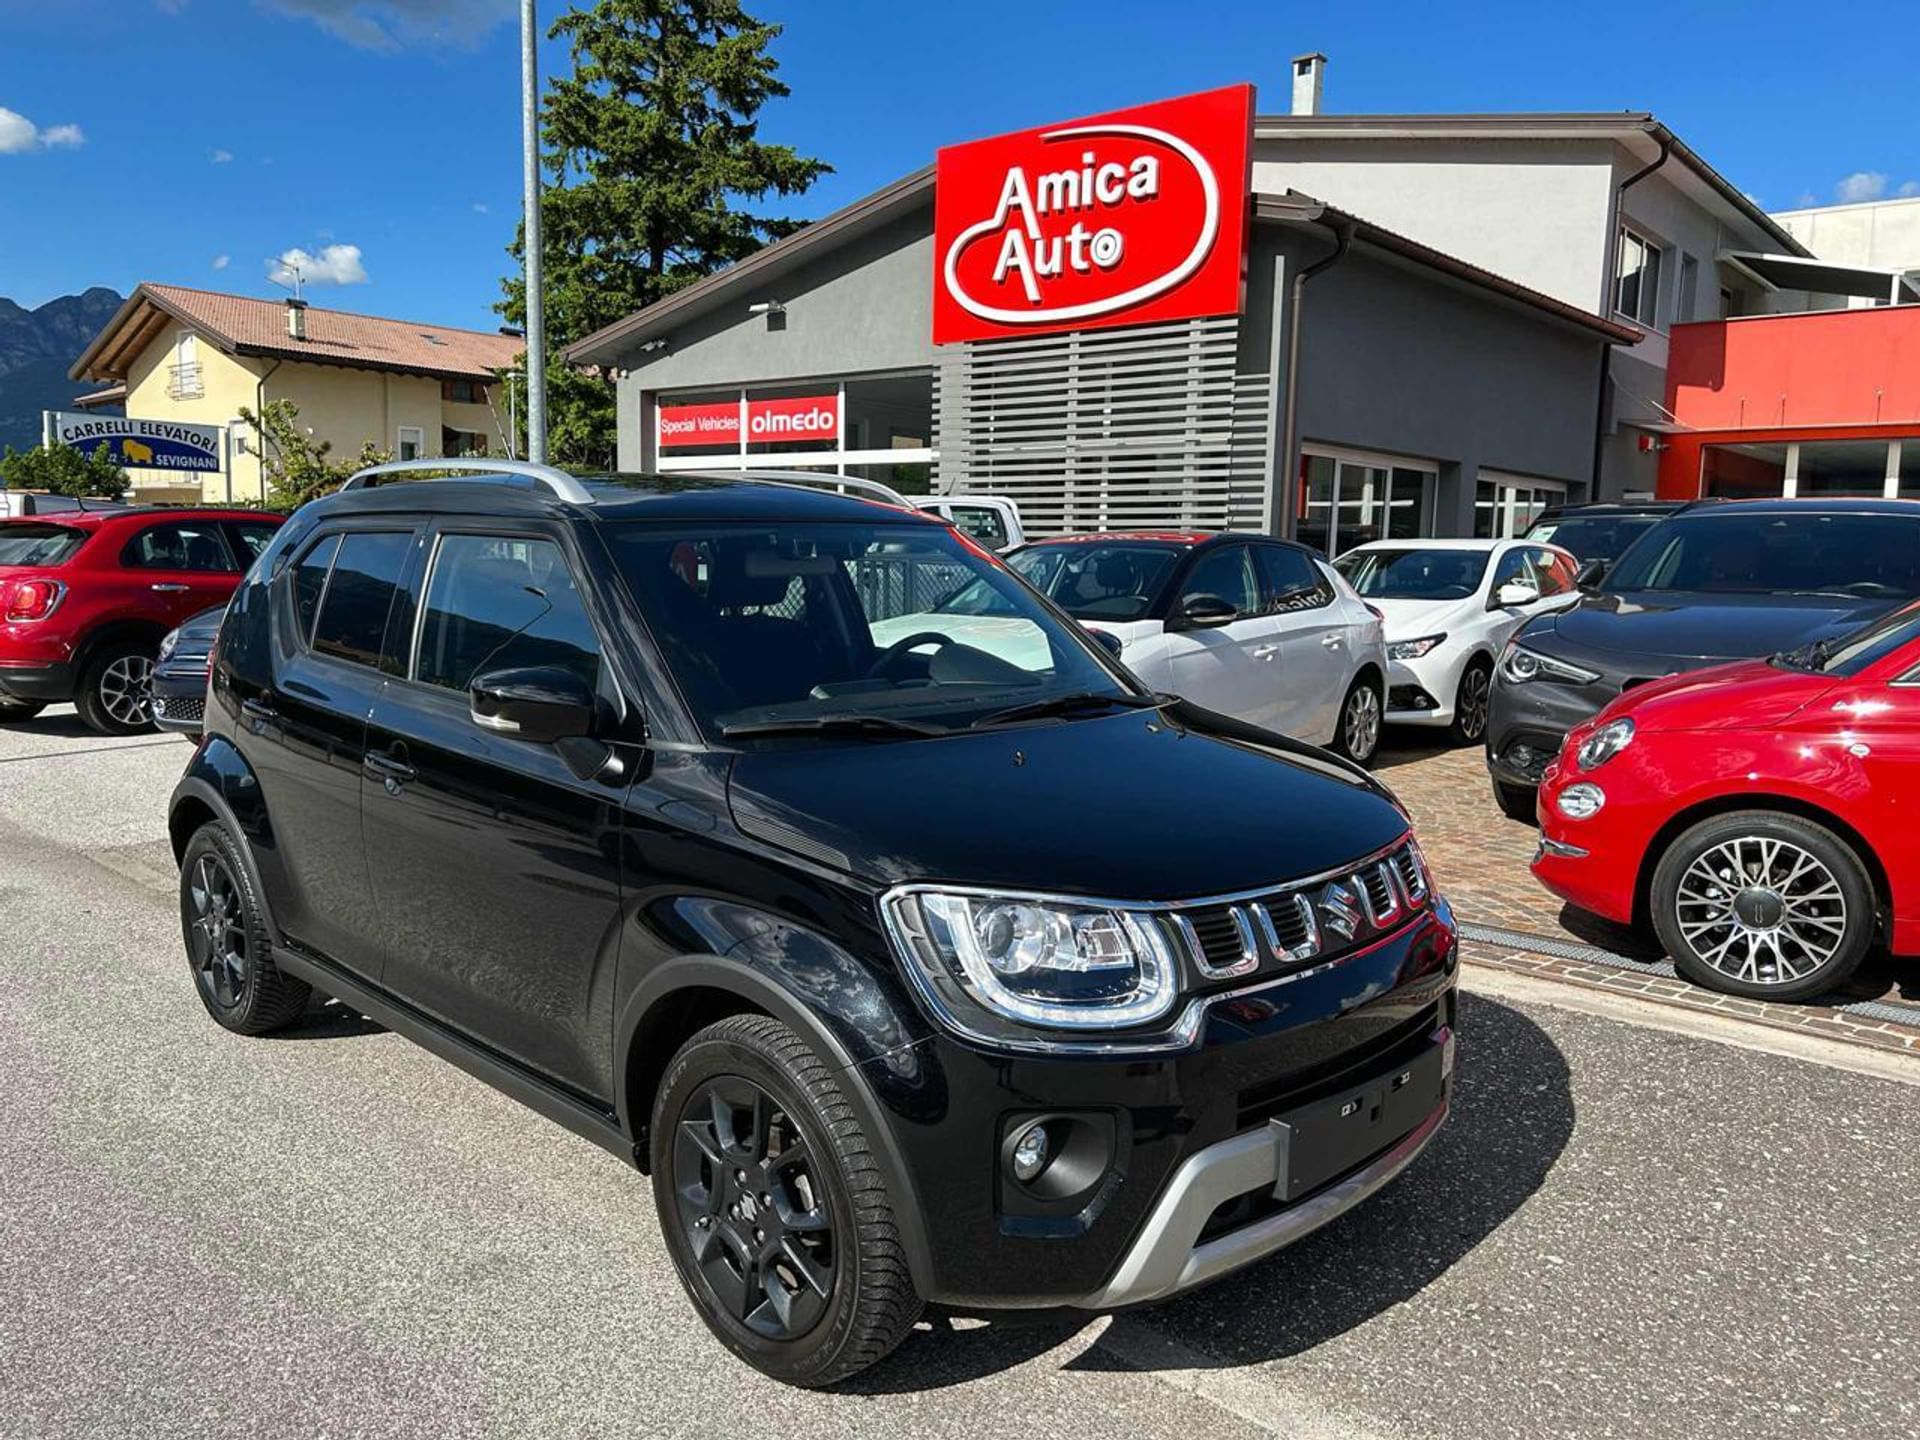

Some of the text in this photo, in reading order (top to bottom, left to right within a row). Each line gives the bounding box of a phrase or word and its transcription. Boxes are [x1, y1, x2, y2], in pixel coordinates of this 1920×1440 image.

[995, 151, 1160, 240] Amica
[992, 222, 1124, 302] Auto
[661, 415, 739, 435] Special Vehicles
[751, 407, 834, 433] olmedo
[63, 421, 216, 452] CARRELLI ELEVATORI
[156, 454, 217, 469] SEVIGNANI
